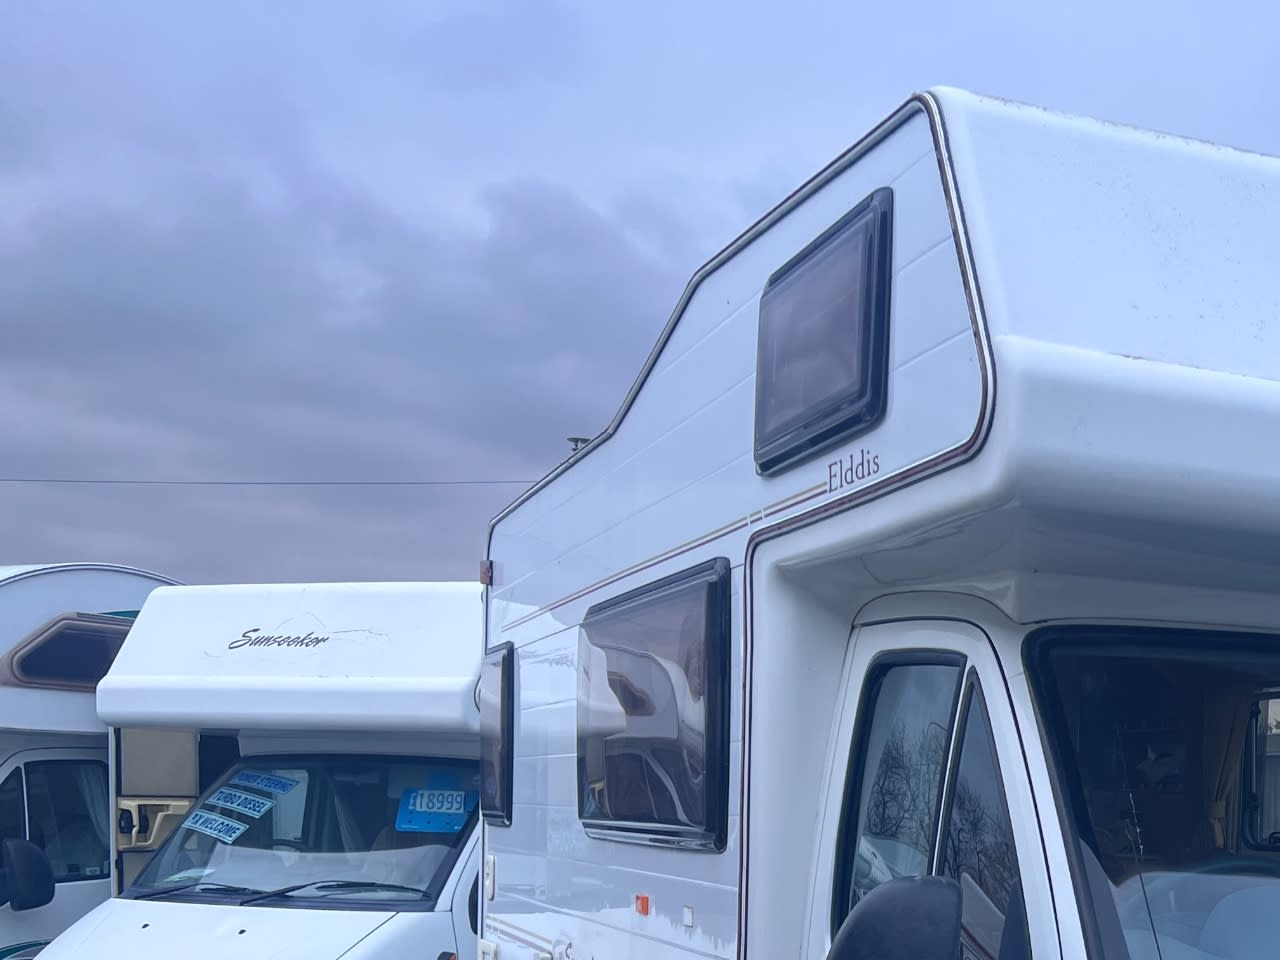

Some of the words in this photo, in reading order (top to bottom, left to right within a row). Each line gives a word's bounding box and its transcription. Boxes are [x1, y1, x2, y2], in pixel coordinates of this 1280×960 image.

[828, 448, 880, 493] Elddis
[228, 628, 330, 649] Sunseeker
[237, 797, 268, 813] DIESEL
[199, 817, 241, 839] WELCOME
